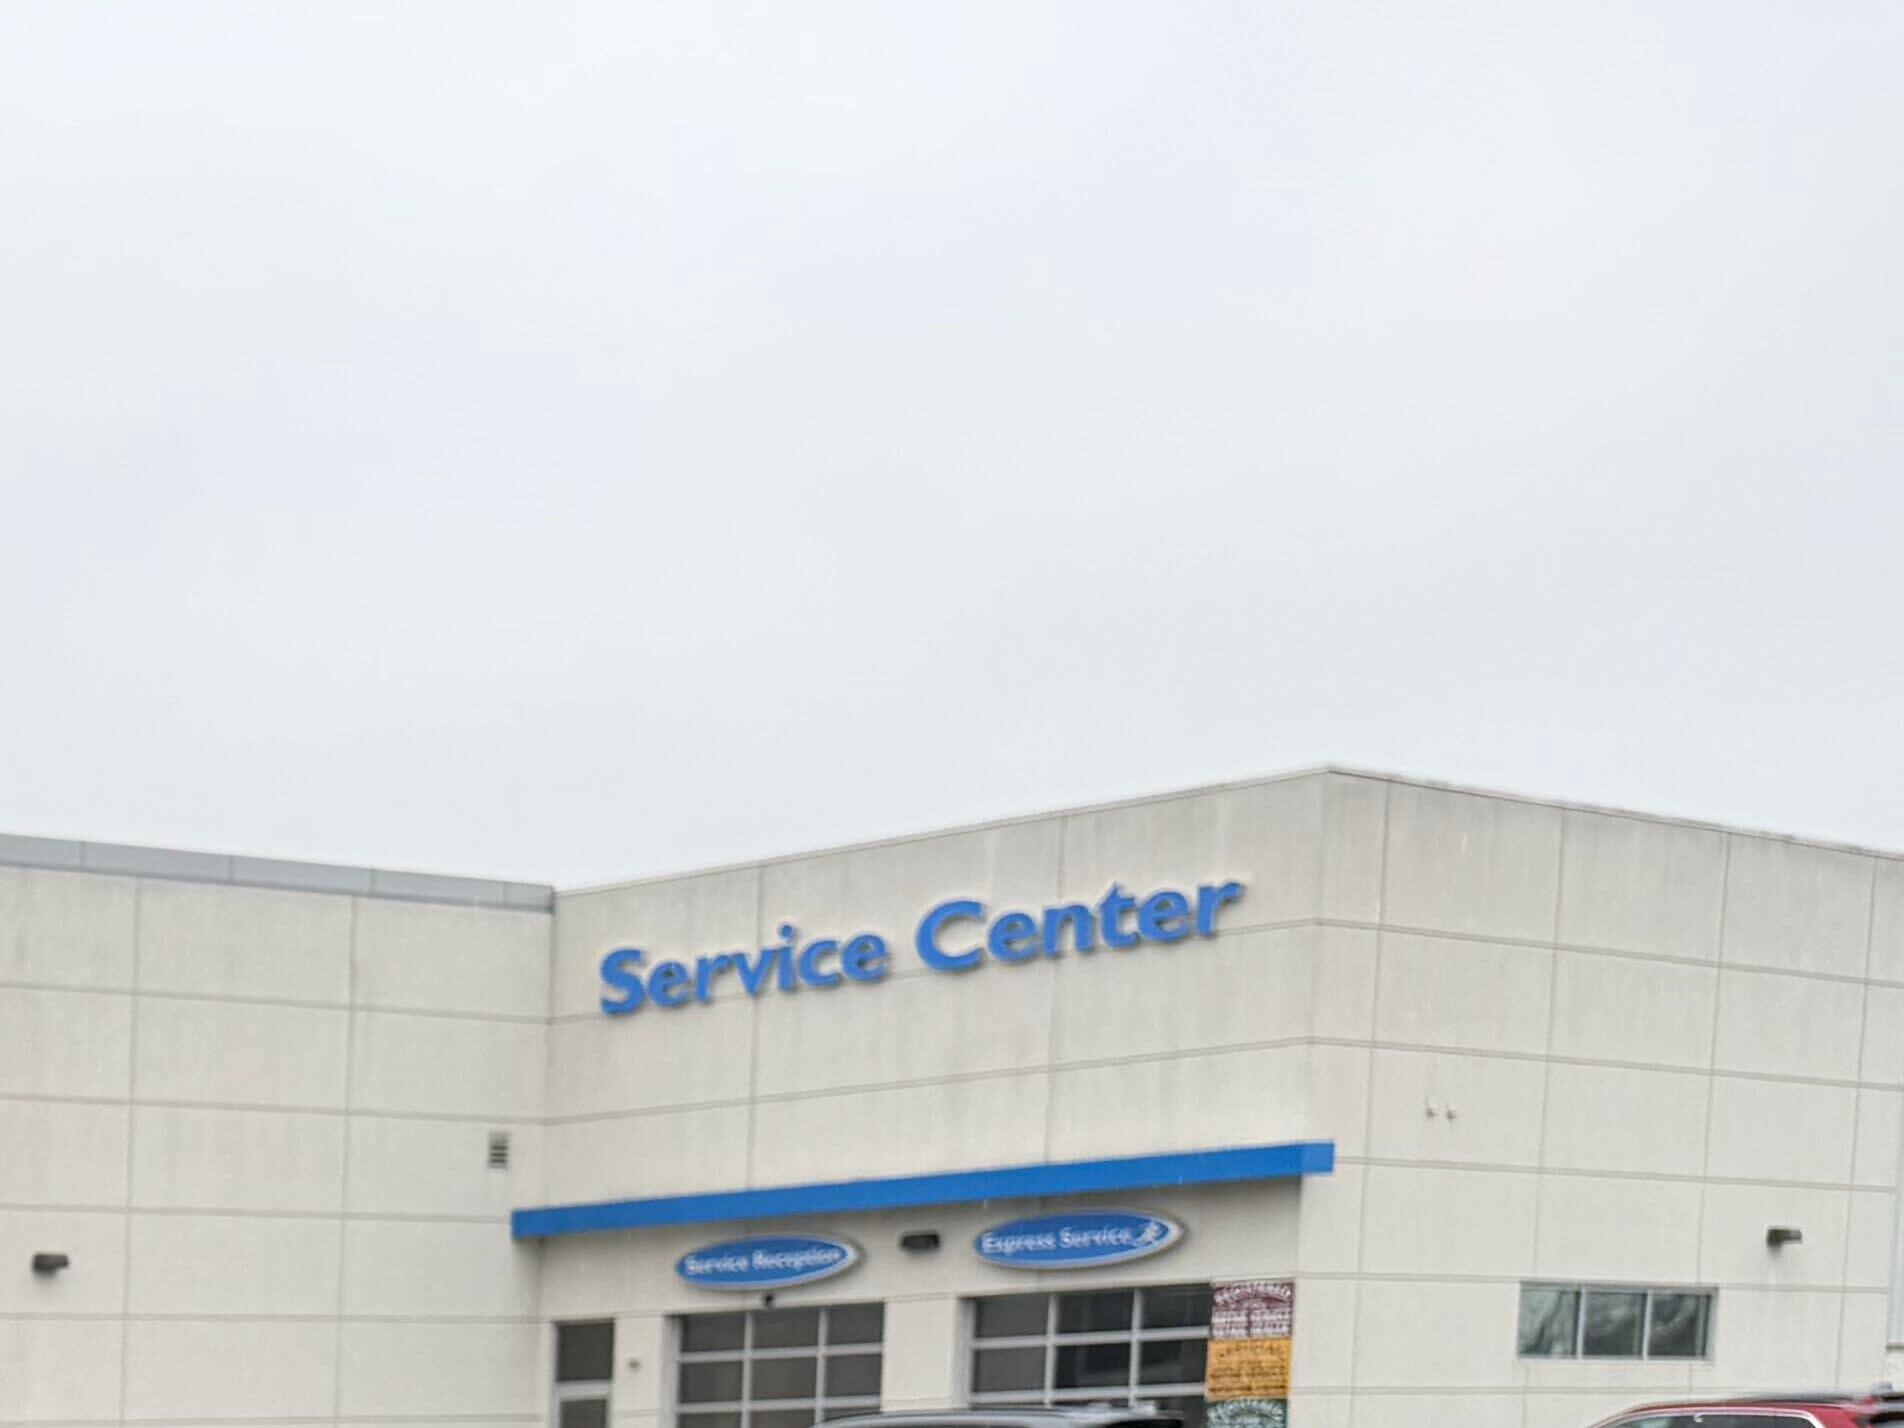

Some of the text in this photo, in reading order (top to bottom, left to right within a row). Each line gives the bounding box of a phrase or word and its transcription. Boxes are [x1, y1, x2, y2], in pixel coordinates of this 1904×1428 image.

[600, 881, 1246, 1017] Service Center
[1059, 1222, 1133, 1248] Service
